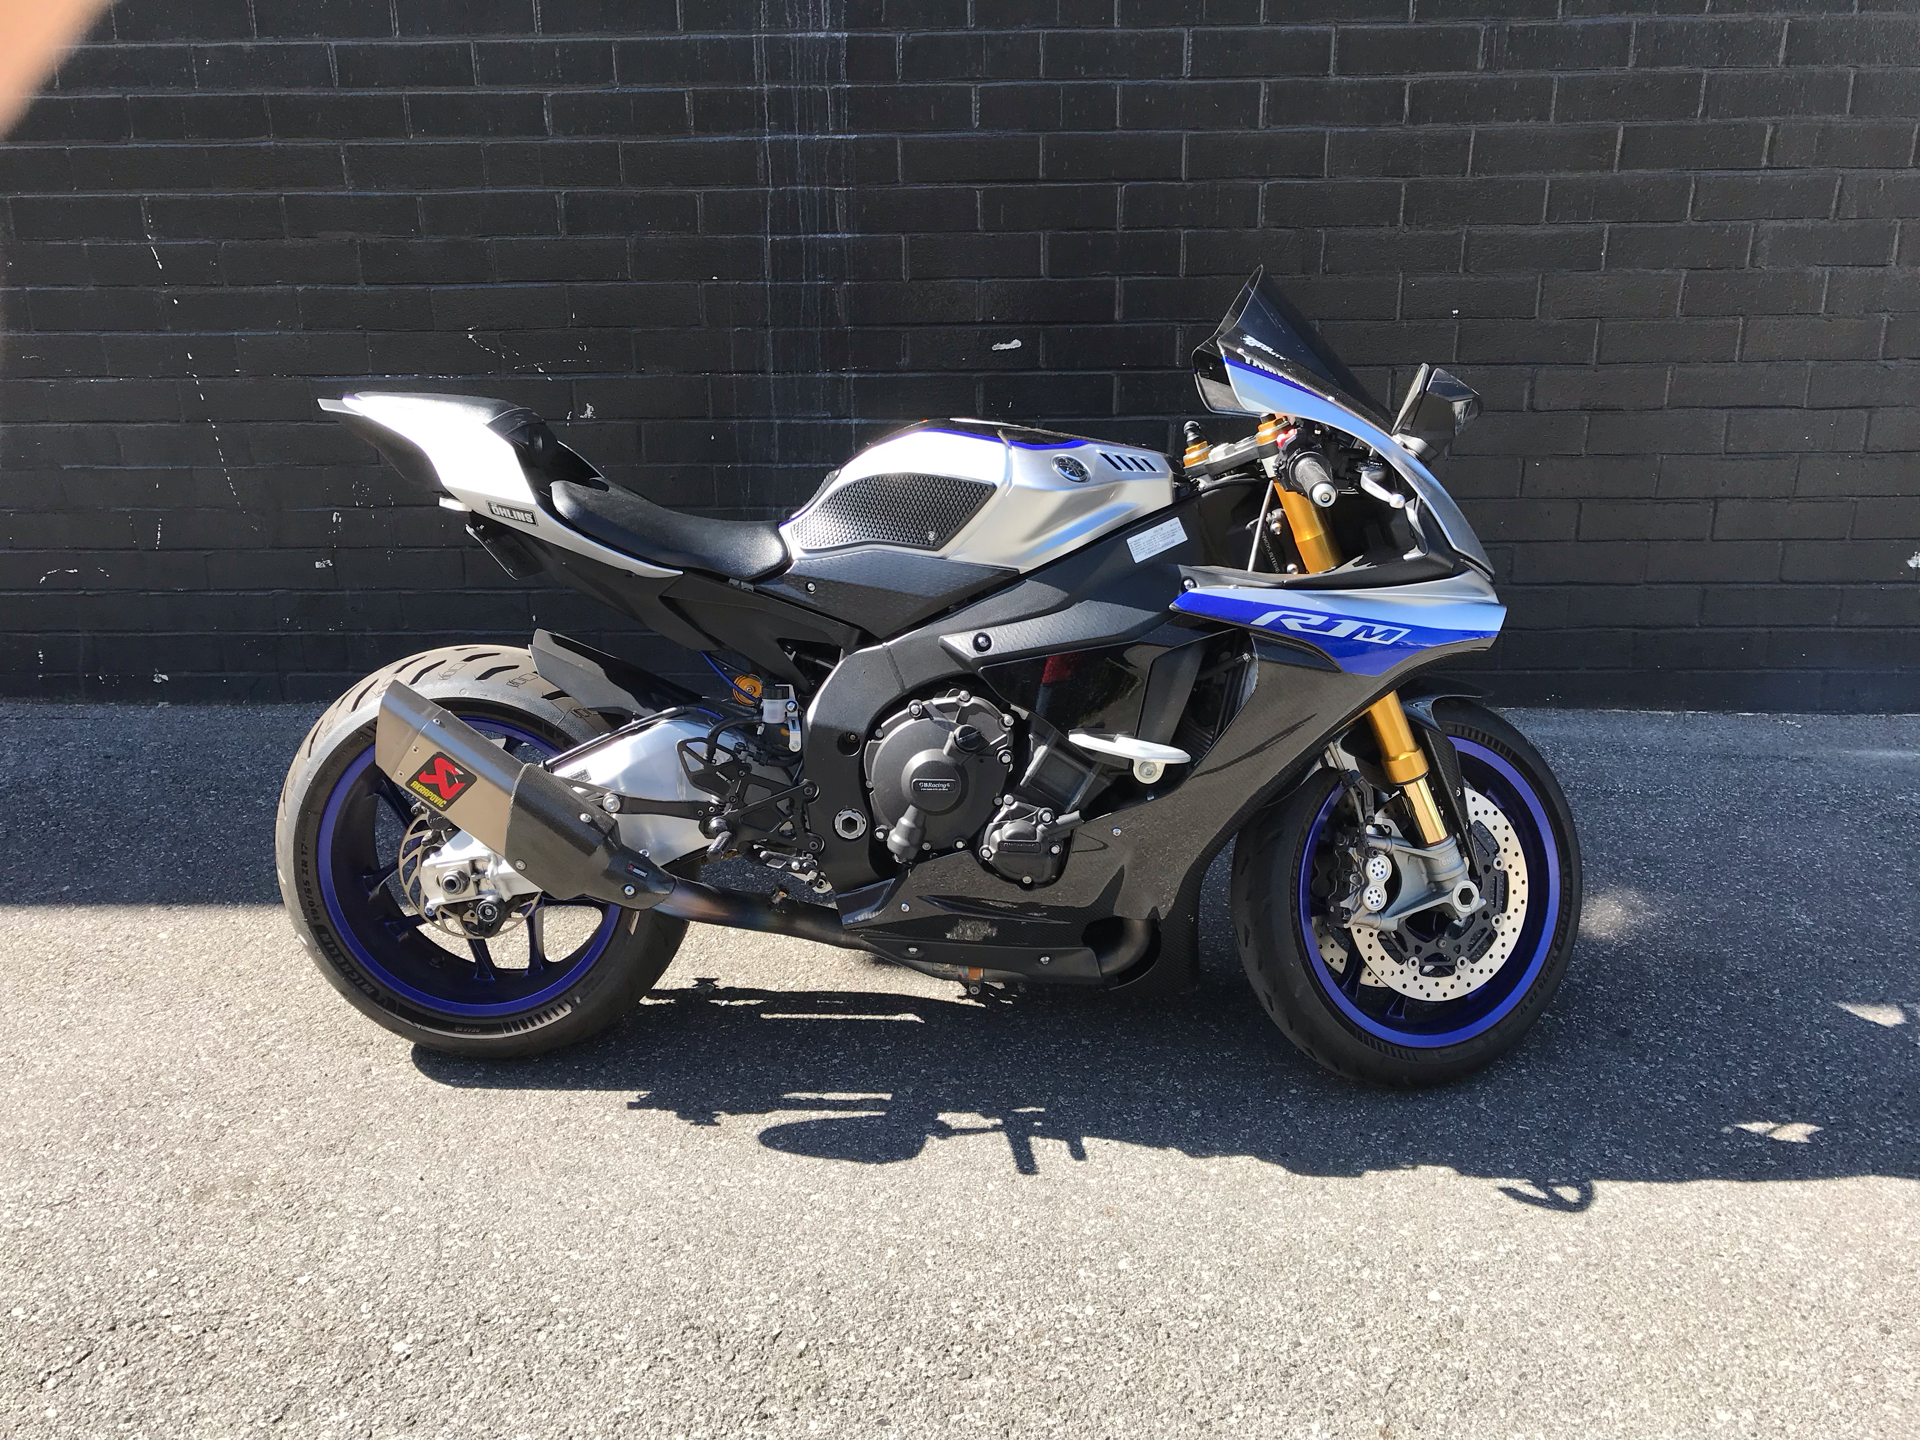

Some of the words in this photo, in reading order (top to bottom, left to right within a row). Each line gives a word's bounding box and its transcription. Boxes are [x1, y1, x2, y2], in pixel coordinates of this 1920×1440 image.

[491, 503, 534, 523] ÖHLINS
[1250, 610, 1412, 645] R1M
[319, 932, 376, 995] MICHELIN
